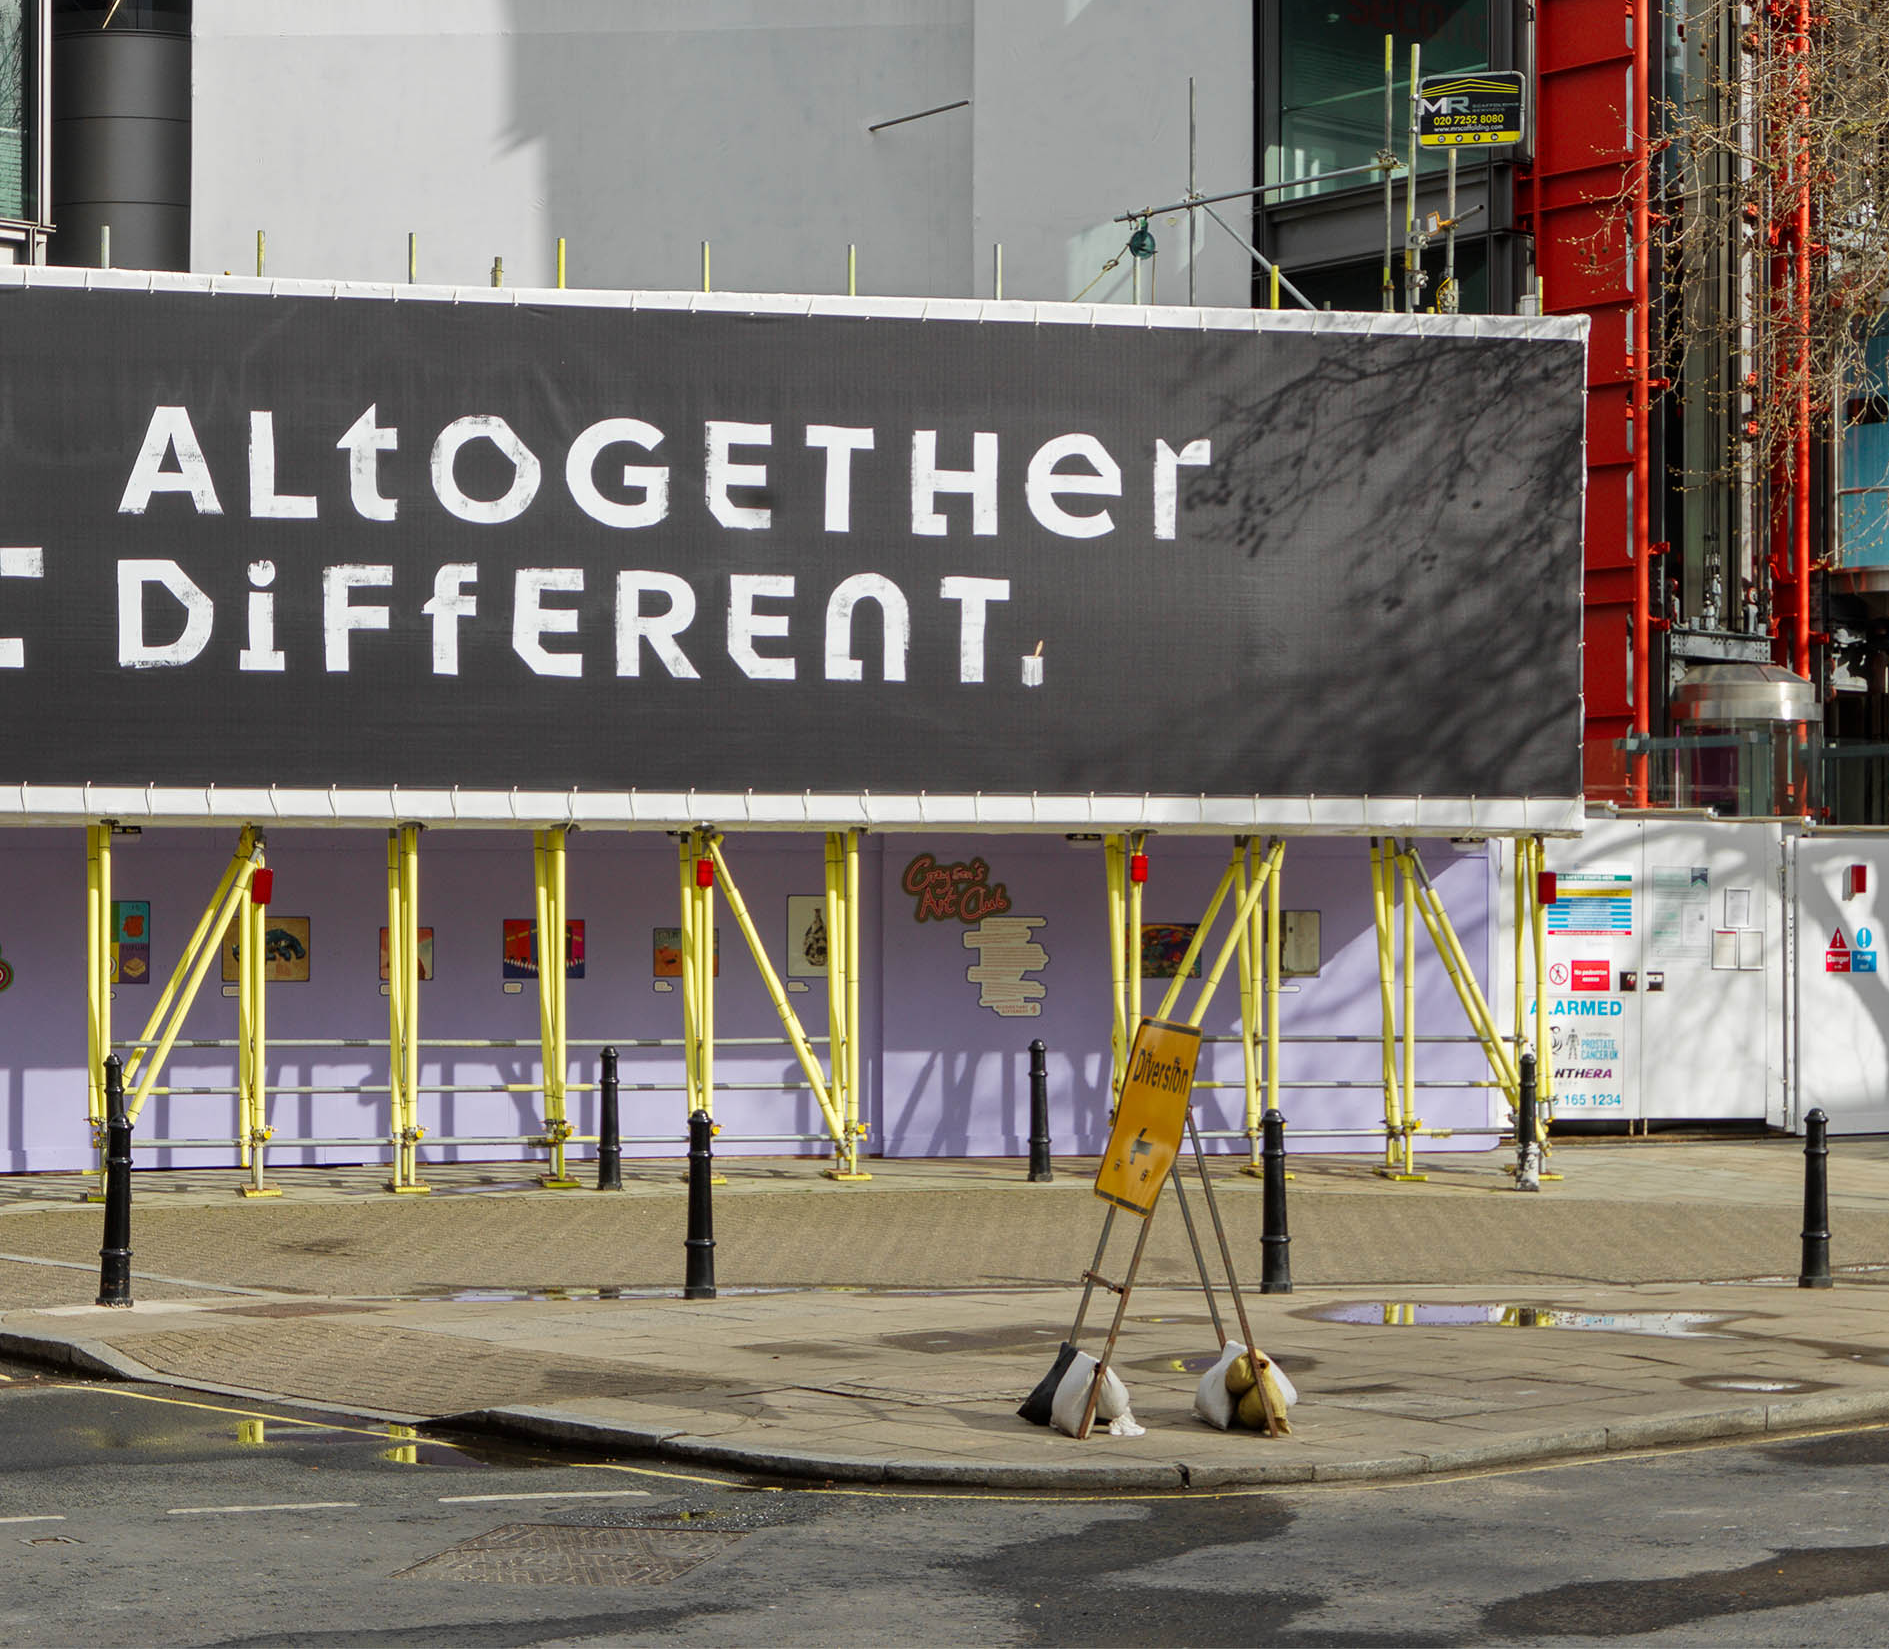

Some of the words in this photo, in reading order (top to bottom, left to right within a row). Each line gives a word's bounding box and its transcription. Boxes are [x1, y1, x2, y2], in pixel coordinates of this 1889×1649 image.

[1418, 96, 1470, 115] MR
[1434, 116, 1451, 125] 020
[1454, 115, 1477, 124] 7252
[1480, 114, 1504, 123] 8080
[919, 887, 957, 918] Art
[960, 886, 1008, 920] Club
[1529, 1000, 1622, 1016] AARMED
[1133, 1048, 1189, 1096] Diversion
[1554, 1068, 1613, 1079] NTHERA
[1565, 1094, 1587, 1106] 165
[1592, 1094, 1622, 1106] 1234
